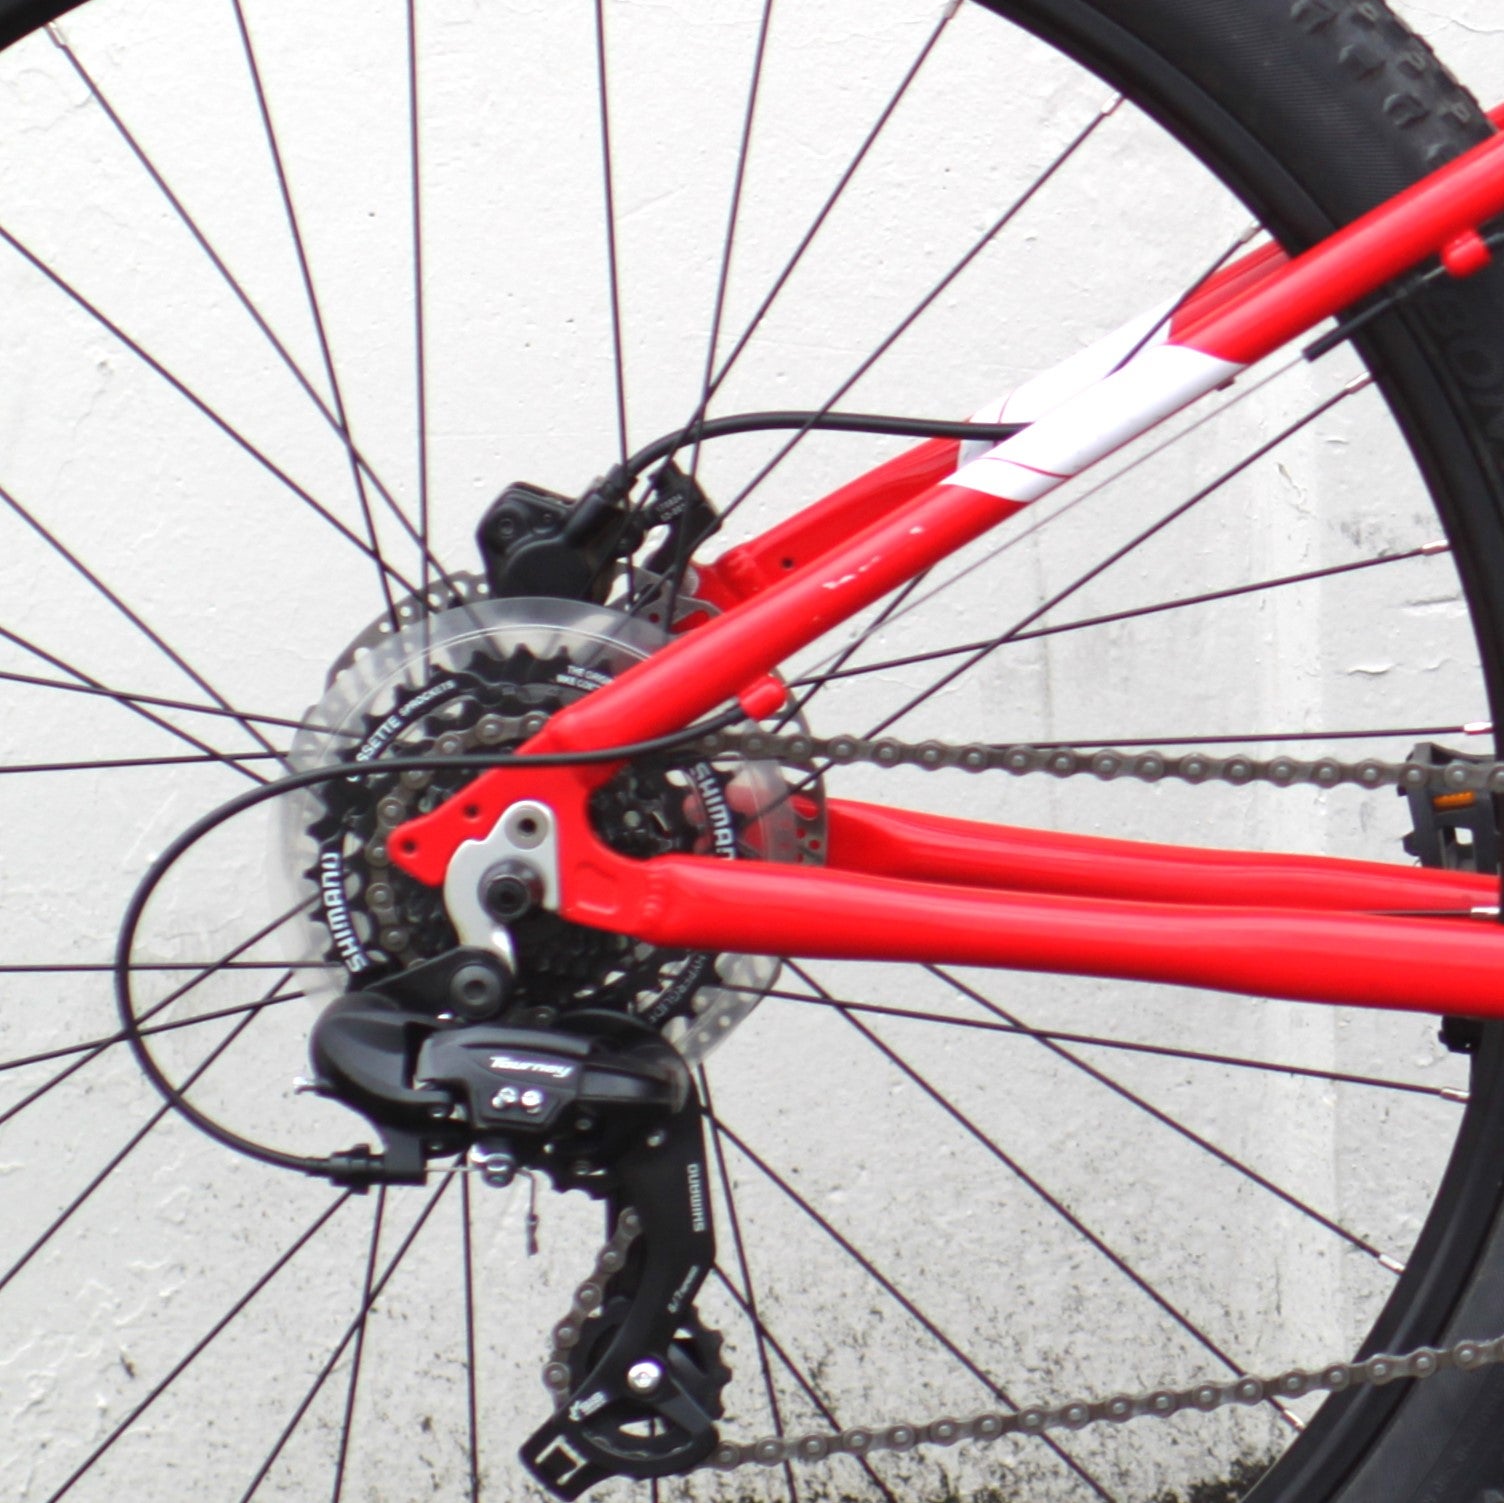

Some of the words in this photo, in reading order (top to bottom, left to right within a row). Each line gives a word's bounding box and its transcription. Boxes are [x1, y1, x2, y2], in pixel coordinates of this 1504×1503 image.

[346, 715, 399, 782] SSETTE
[320, 851, 371, 973] SHIMANO
[489, 1054, 574, 1078] Tourney
[686, 1162, 706, 1232] SHIMANO
